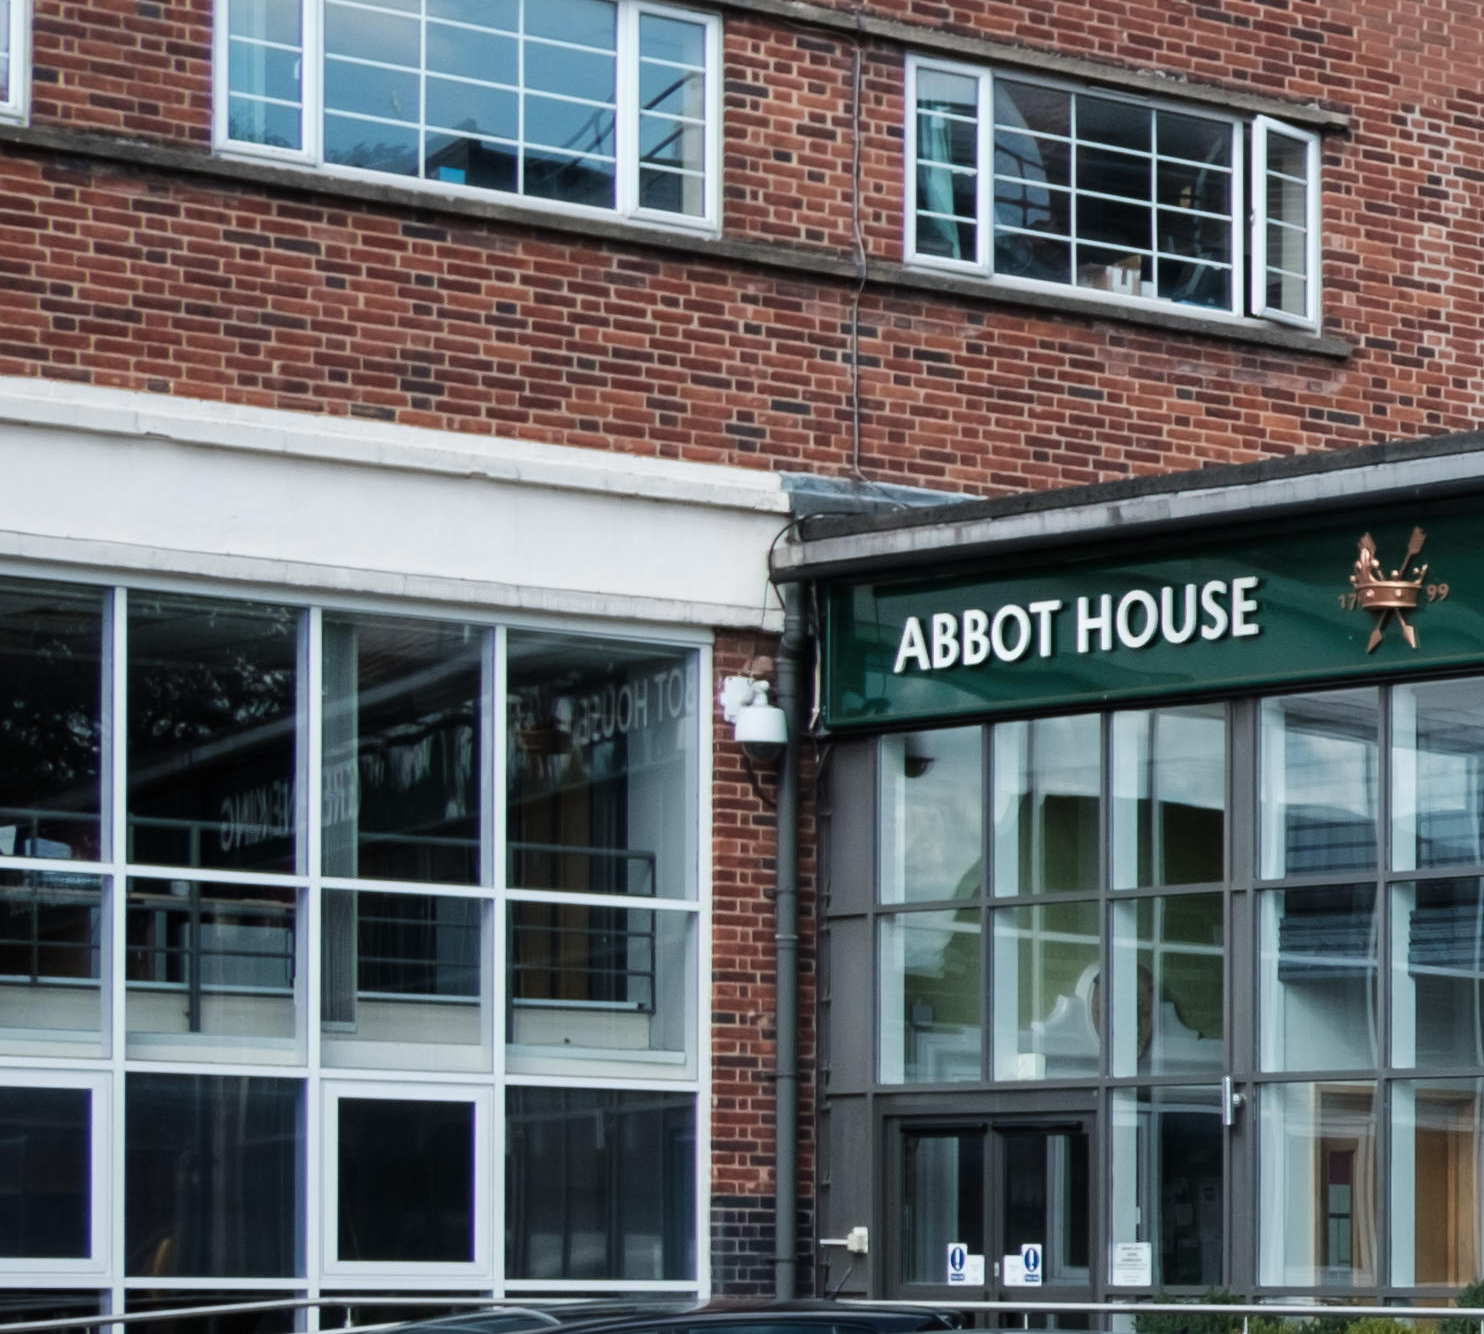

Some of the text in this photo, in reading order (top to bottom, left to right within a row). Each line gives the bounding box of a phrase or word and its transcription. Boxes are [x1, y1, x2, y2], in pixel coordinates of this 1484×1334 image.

[1427, 583, 1450, 603] 99
[894, 576, 1260, 673] ABBOT HOUSE
